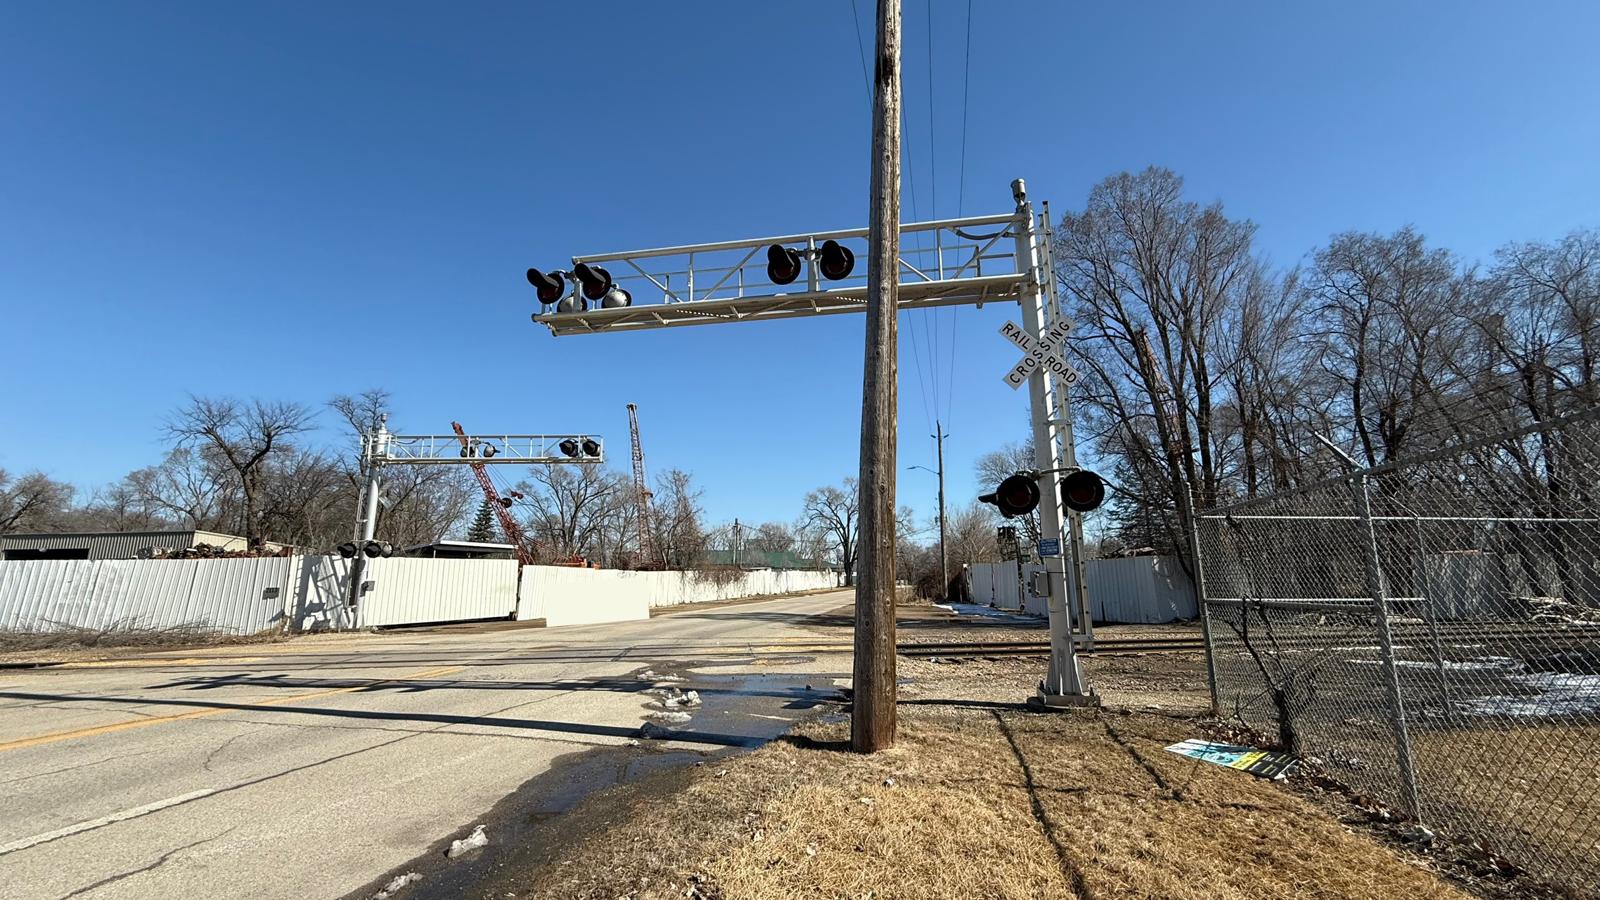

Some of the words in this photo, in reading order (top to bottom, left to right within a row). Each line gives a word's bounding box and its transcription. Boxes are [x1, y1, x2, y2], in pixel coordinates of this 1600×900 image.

[1002, 323, 1031, 350] RAIL
[1044, 355, 1077, 384] ROAD
[1009, 321, 1070, 384] CROSSING
